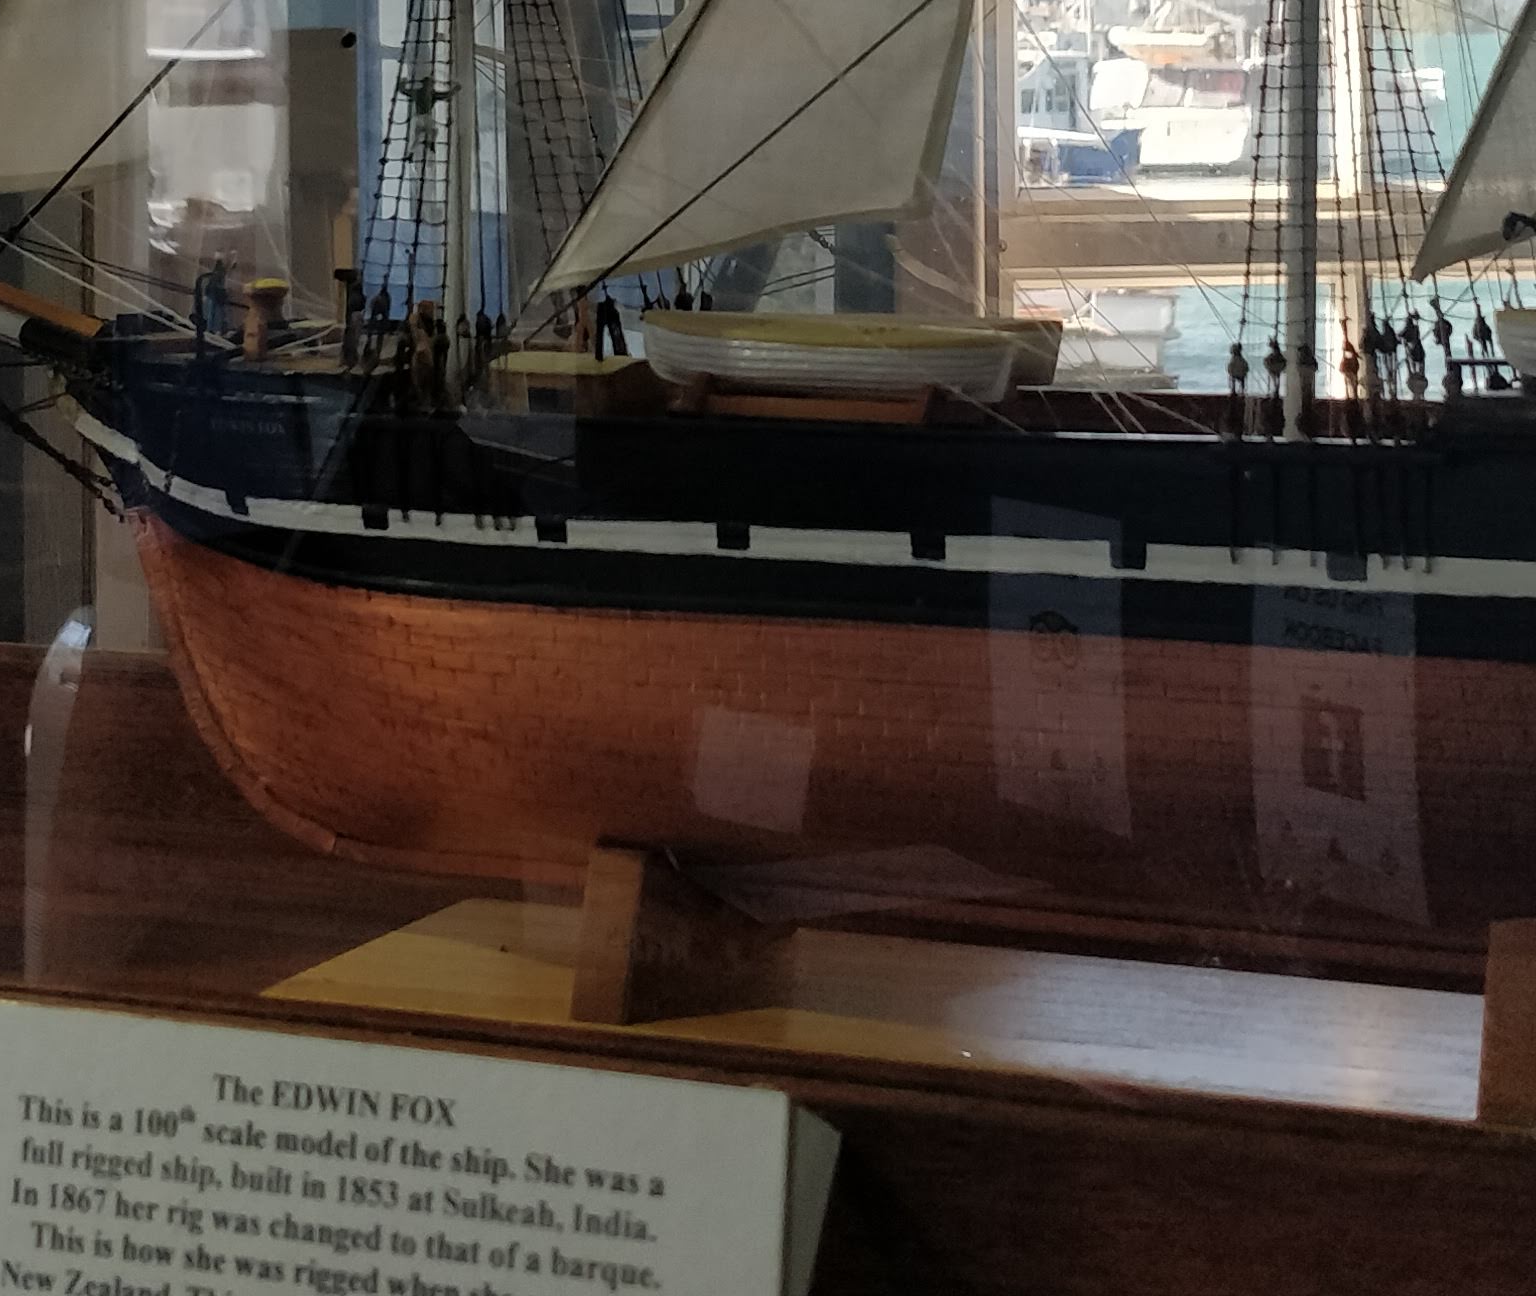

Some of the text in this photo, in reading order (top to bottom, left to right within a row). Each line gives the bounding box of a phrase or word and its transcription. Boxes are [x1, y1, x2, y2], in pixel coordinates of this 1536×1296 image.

[213, 1073, 457, 1128] The EDWIN FOX
[19, 1094, 74, 1127] This
[81, 1100, 102, 1129] is
[108, 1111, 123, 1133] a
[204, 1119, 267, 1149] scale
[275, 1129, 358, 1163] model
[364, 1136, 395, 1165] of
[399, 1140, 444, 1171] the
[524, 1151, 575, 1186] She
[584, 1167, 640, 1193] was
[649, 1175, 666, 1197] a
[21, 1136, 64, 1167] full
[71, 1144, 154, 1180] rigged
[230, 1159, 292, 1197] built
[301, 1170, 326, 1200] in
[338, 1174, 401, 1209] 1853
[407, 1188, 434, 1213] at
[11, 1176, 39, 1207] In
[49, 1183, 108, 1215] 1867
[115, 1192, 160, 1222] her
[166, 1197, 204, 1235] rig
[212, 1211, 261, 1236] was
[268, 1211, 382, 1253] changed
[390, 1229, 417, 1256] to
[425, 1230, 481, 1265] that
[488, 1241, 521, 1271] of
[524, 1250, 541, 1274] a
[30, 1220, 85, 1255] This
[93, 1229, 113, 1259] is
[122, 1233, 175, 1266] how
[183, 1244, 227, 1275] she
[234, 1255, 286, 1283] was
[293, 1258, 379, 1296] rigged
[1, 1258, 56, 1292] New
